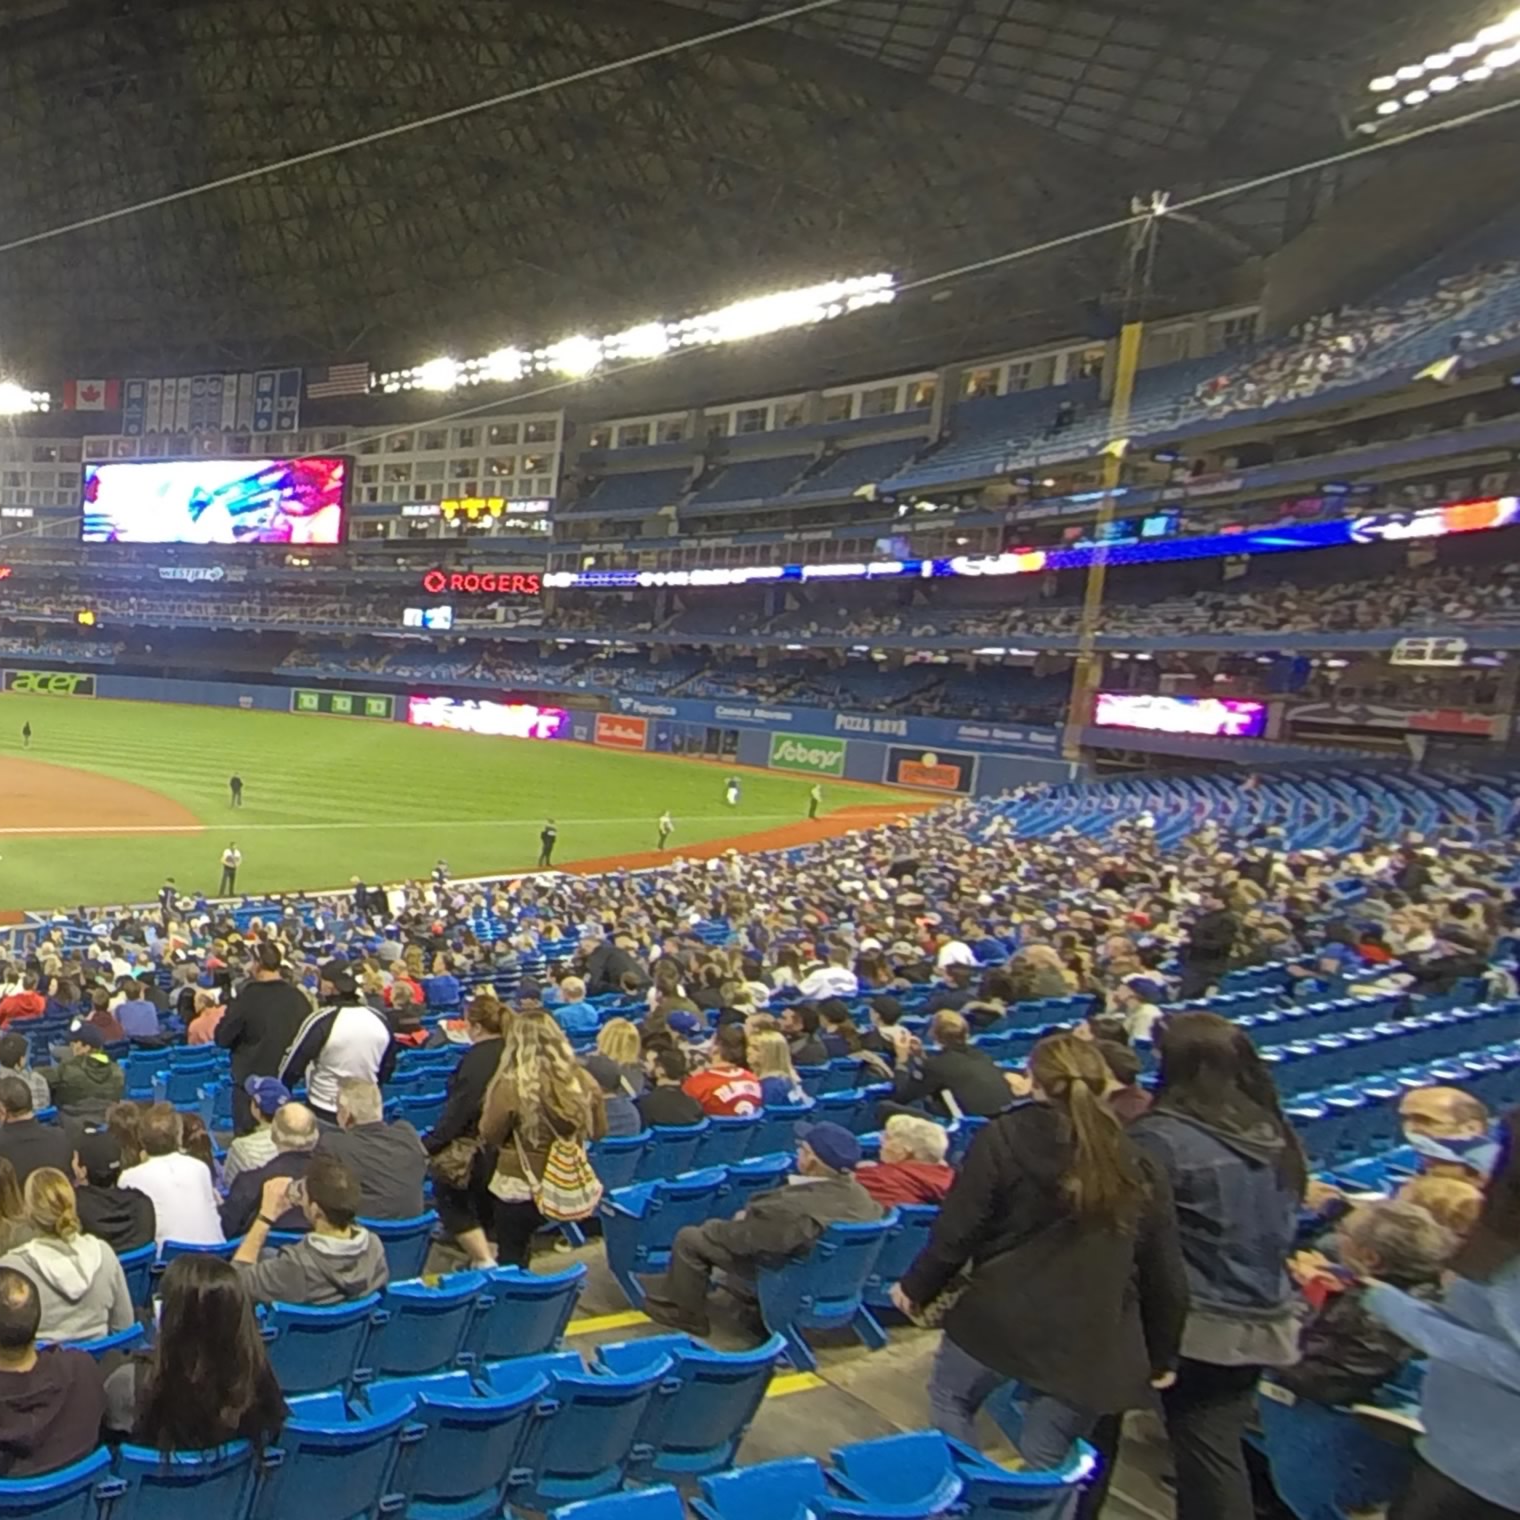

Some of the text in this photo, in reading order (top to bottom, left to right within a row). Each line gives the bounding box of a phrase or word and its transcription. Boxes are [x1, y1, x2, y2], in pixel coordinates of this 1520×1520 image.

[256, 398, 272, 413] 12
[450, 573, 540, 594] ROGERS
[11, 671, 88, 695] acer
[835, 714, 870, 733] PIZZA
